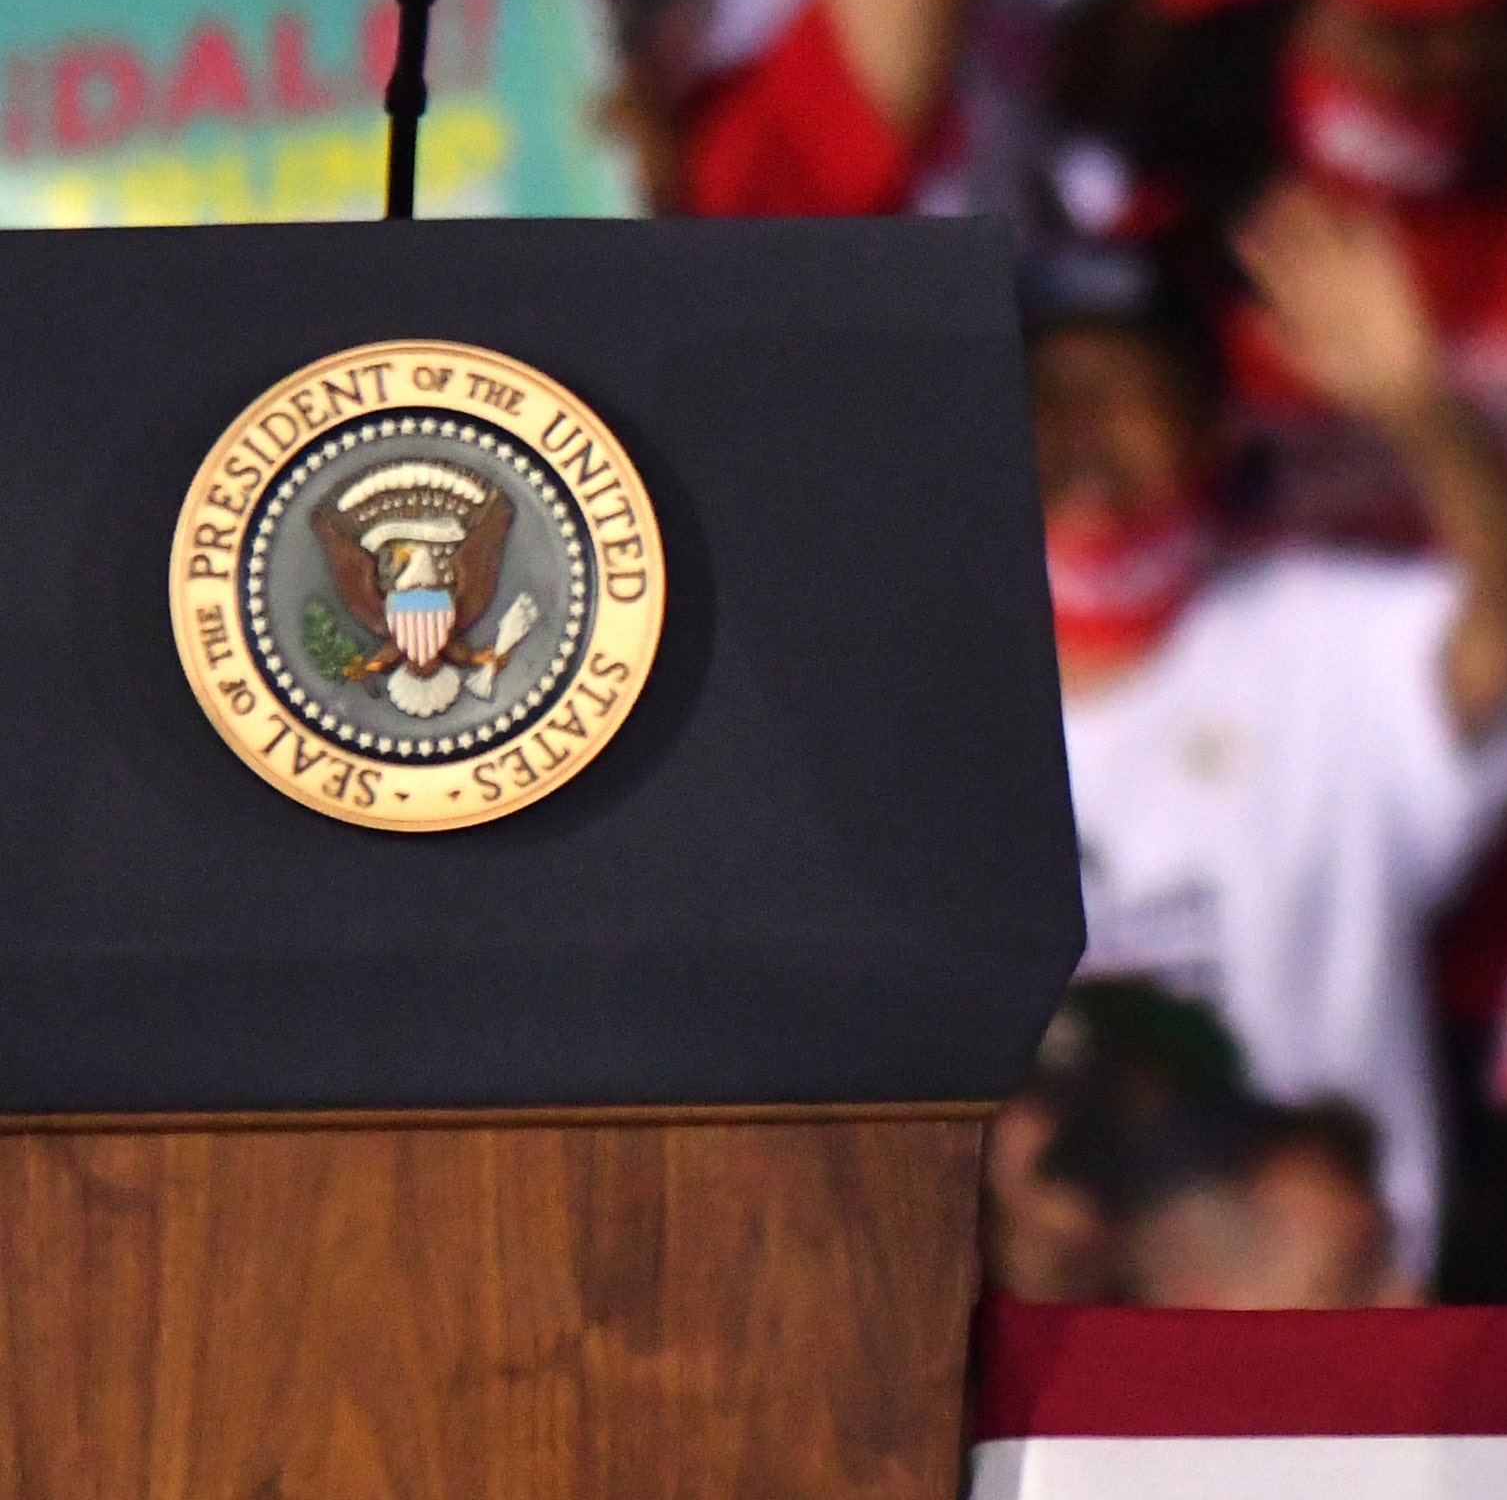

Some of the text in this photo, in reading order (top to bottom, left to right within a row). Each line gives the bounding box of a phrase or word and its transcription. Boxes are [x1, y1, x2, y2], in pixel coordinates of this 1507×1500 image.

[188, 361, 649, 810] SEAL OF THE PRESIDENT OF THE UNITED STATES
